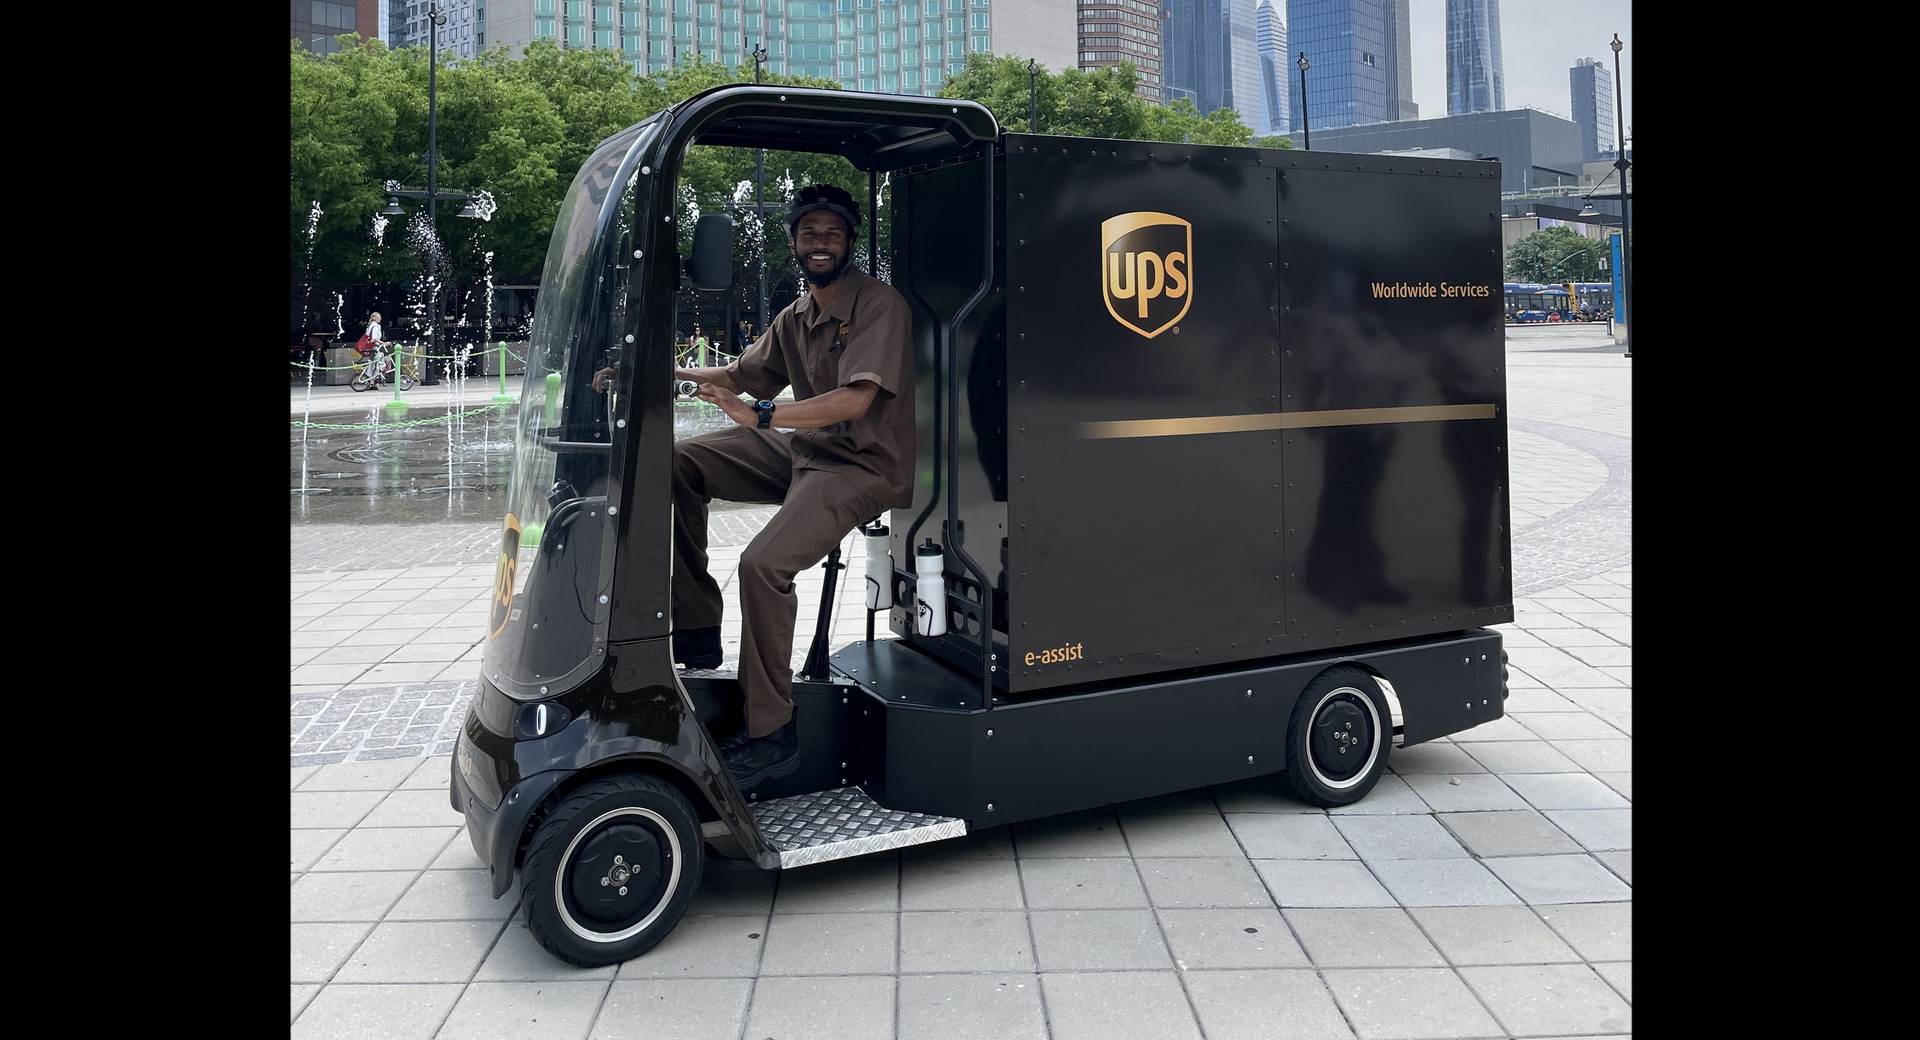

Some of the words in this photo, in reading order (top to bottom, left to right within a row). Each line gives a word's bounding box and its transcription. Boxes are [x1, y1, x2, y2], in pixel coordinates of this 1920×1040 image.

[1109, 251, 1187, 318] ups
[1371, 282, 1437, 298] Worldwide
[1440, 281, 1490, 297] Services
[1024, 642, 1083, 666] e-assist
